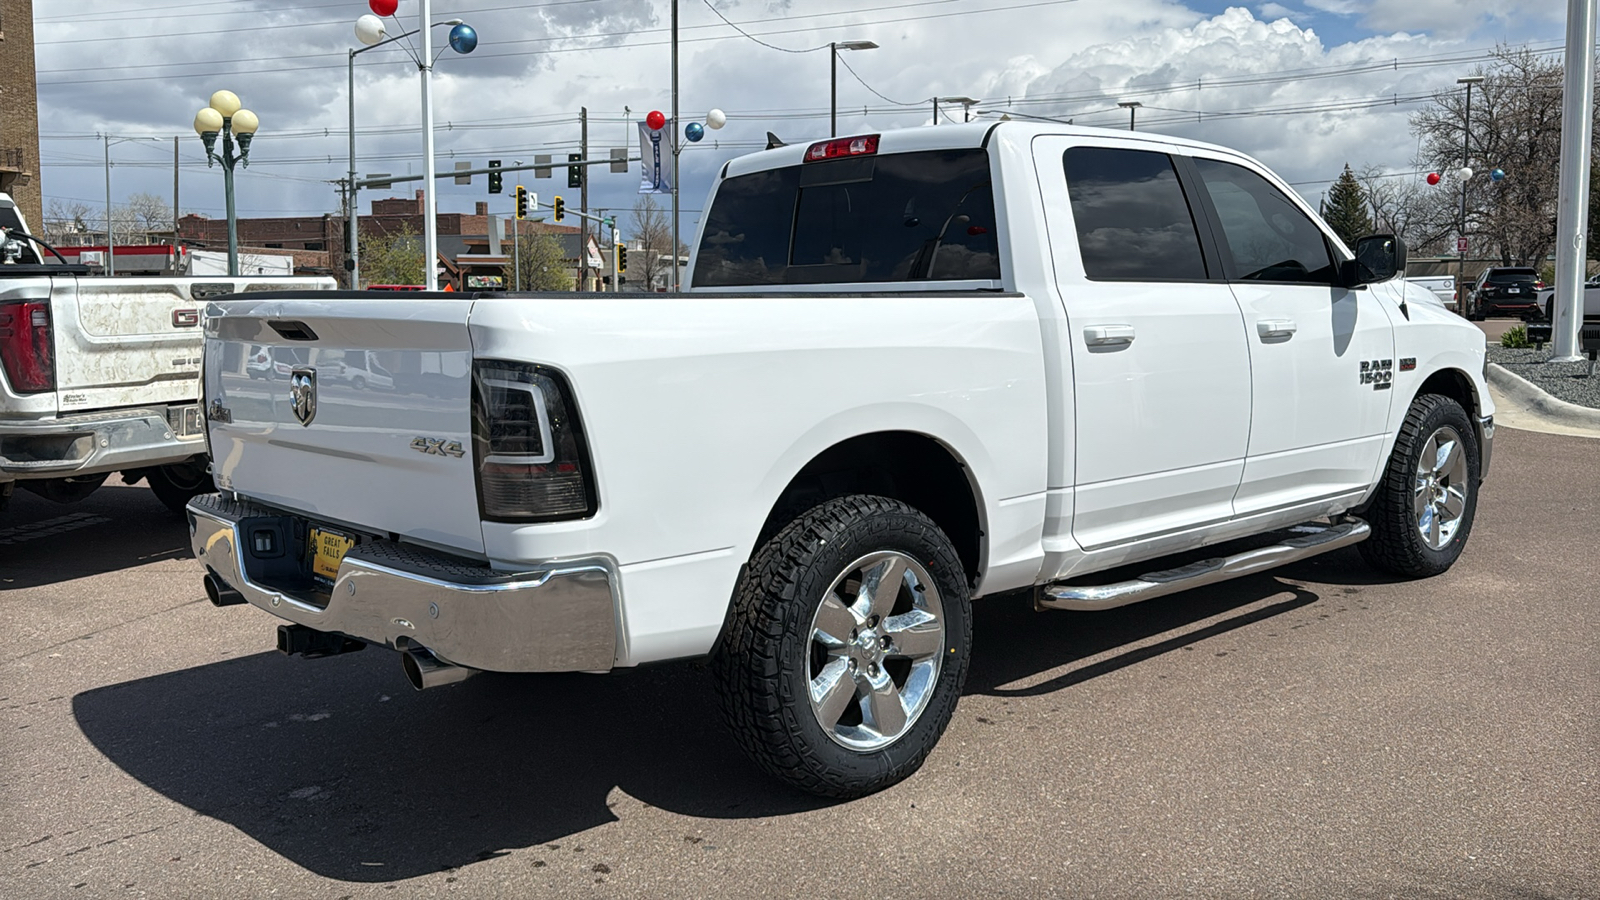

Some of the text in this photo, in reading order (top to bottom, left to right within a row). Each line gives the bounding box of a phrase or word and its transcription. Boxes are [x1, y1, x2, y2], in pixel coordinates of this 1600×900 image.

[1359, 359, 1393, 372] RAM
[1359, 370, 1393, 385] 1500
[409, 435, 466, 459] 4X4
[324, 535, 341, 549] GREAT
[322, 545, 340, 560] FALLS
